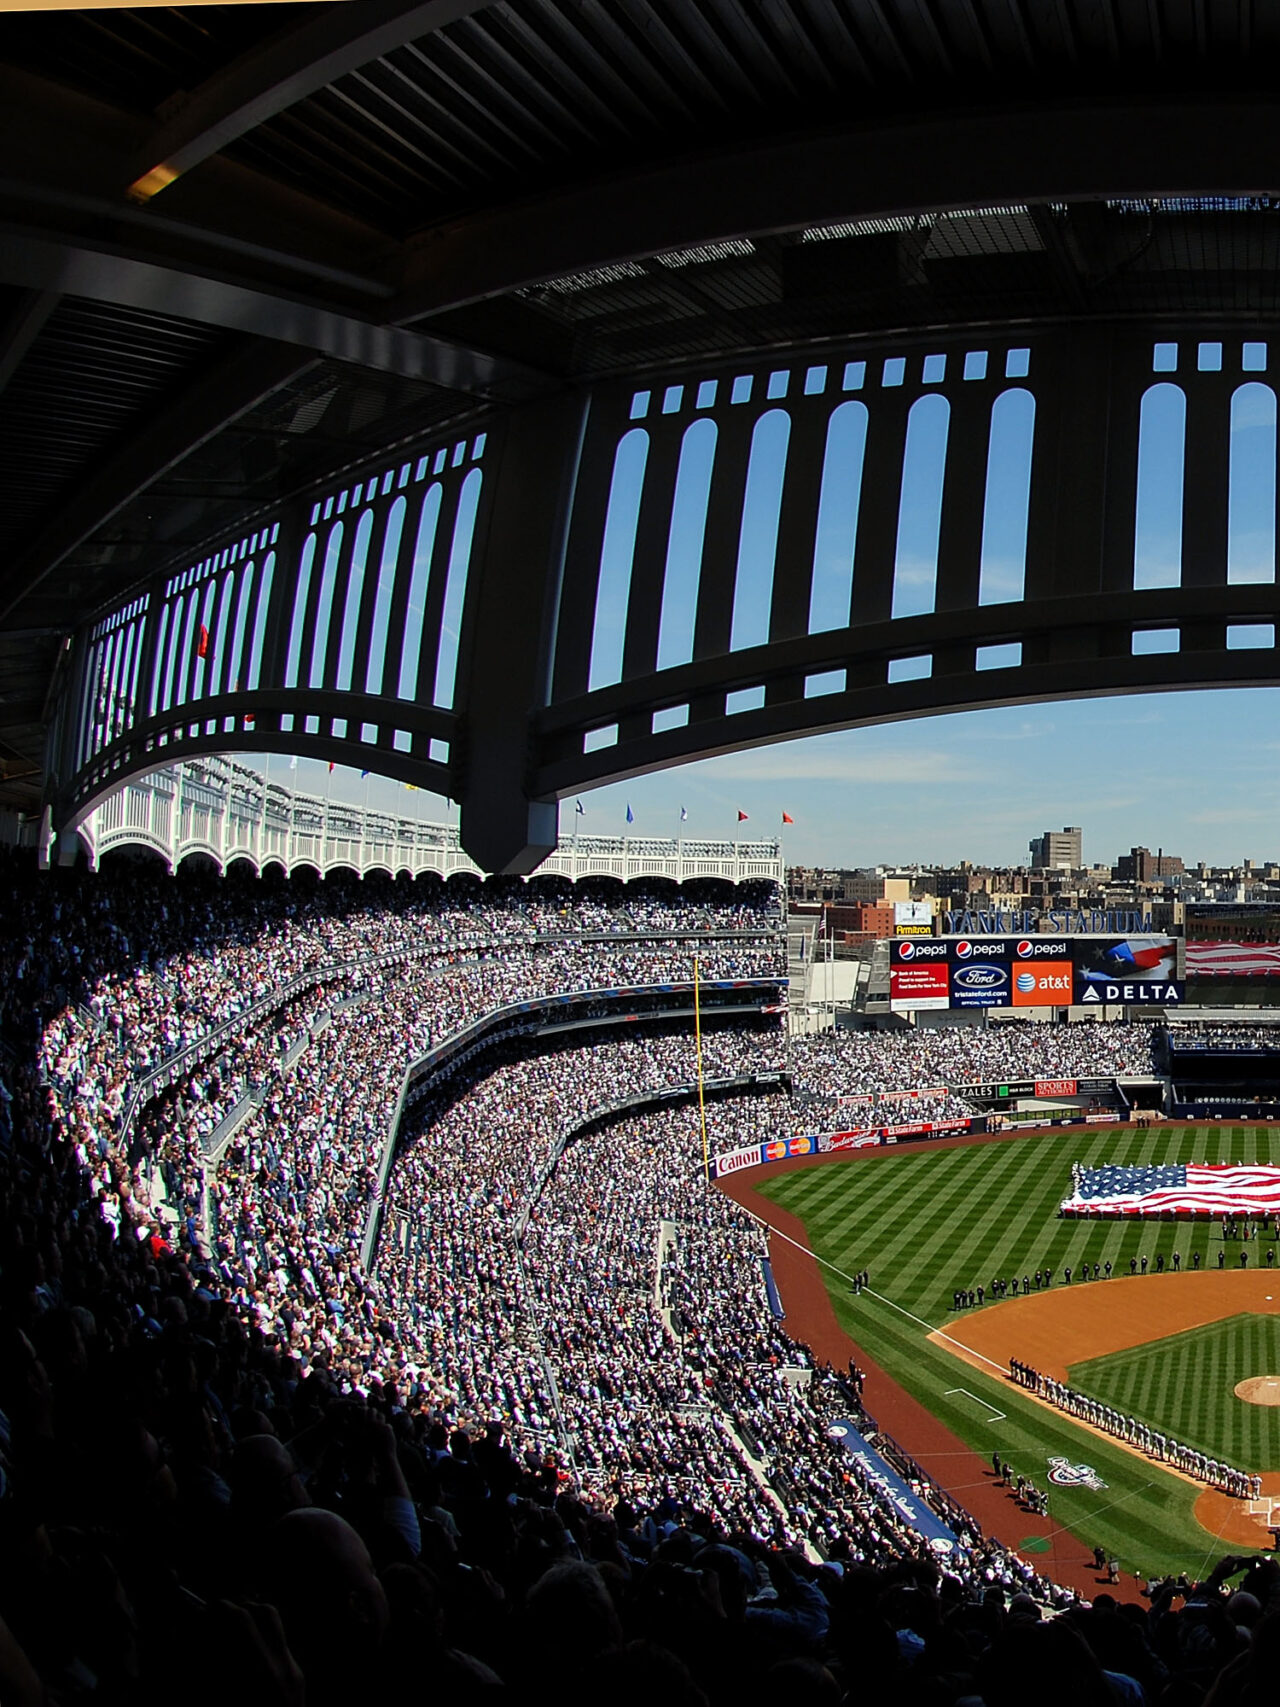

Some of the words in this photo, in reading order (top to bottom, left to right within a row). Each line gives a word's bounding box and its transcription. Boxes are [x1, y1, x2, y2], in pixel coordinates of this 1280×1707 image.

[945, 909, 1036, 934] YANKEE
[1047, 910, 1152, 934] STADIUM
[896, 925, 931, 935] Armitron
[916, 944, 947, 957] pepsi
[973, 943, 1005, 956] pepsi
[1034, 943, 1066, 955] pepsi
[966, 970, 995, 984] Ford
[1039, 975, 1070, 989] at&t
[1106, 985, 1178, 999] DELTA
[962, 1086, 993, 1098] ZALES
[1038, 1081, 1073, 1090] SPORTS
[820, 1130, 872, 1152] Budweiser
[719, 1150, 759, 1172] Canon
